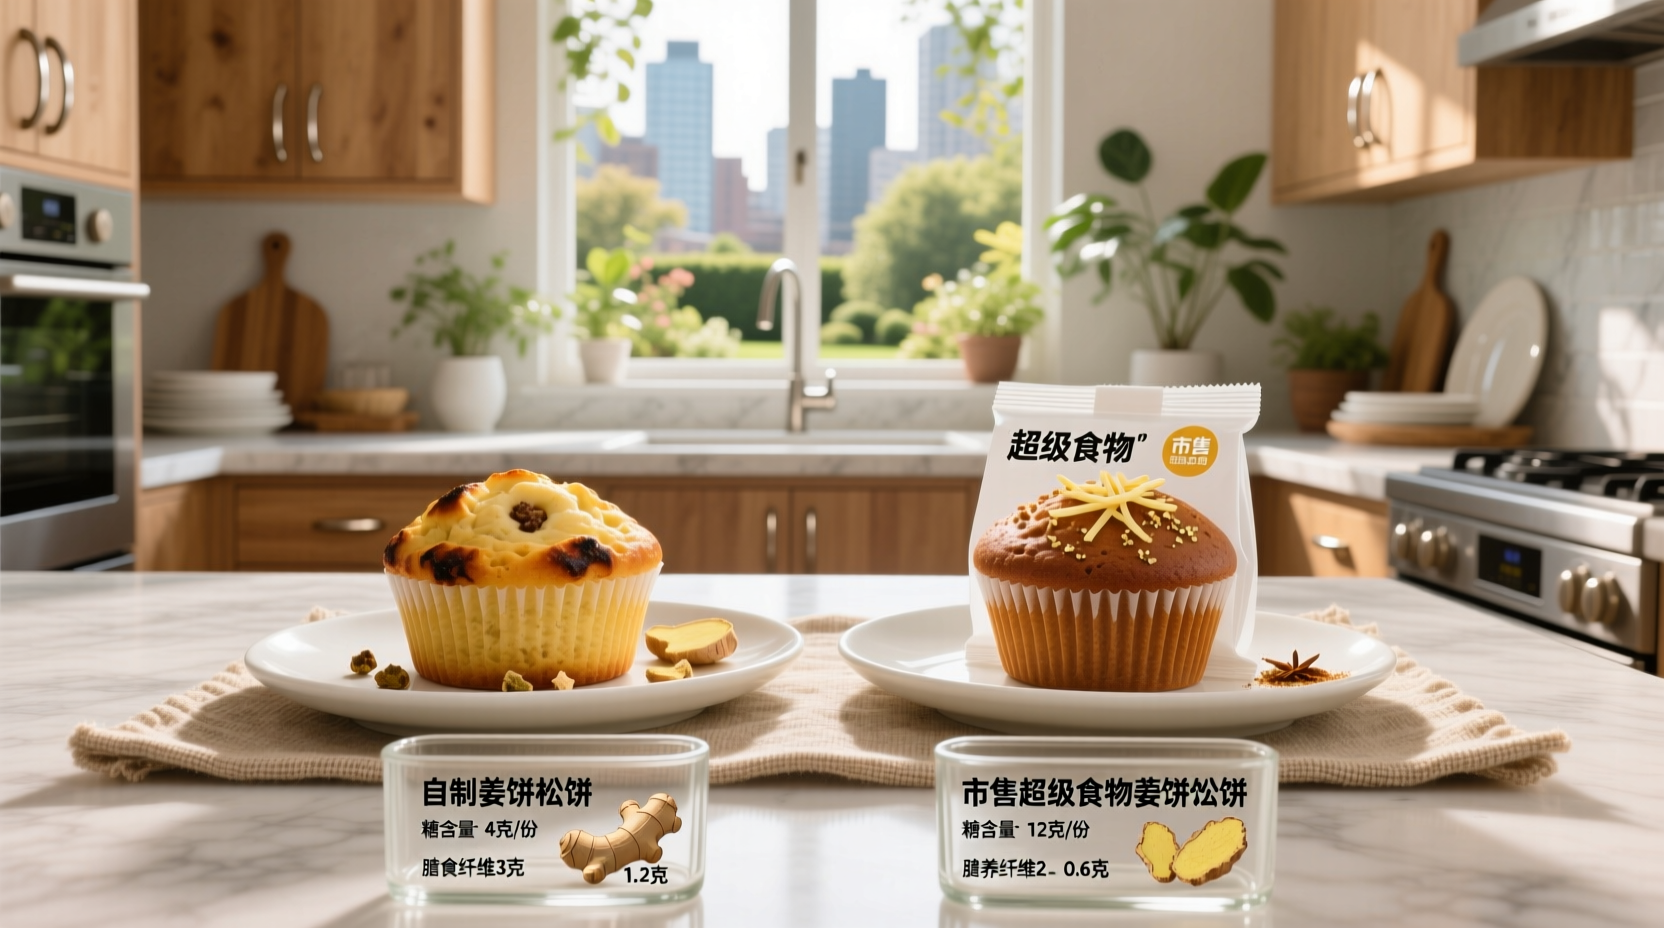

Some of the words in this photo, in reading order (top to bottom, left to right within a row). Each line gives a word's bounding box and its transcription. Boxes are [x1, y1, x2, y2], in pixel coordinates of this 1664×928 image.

[1172, 436, 1212, 456] 市售
[422, 776, 593, 808] 自制姜饼松饼
[484, 819, 539, 840] 4克/份
[1027, 819, 1091, 840] 12克/份
[623, 865, 669, 885] 1.2克
[1063, 858, 1110, 879] 0.6克
